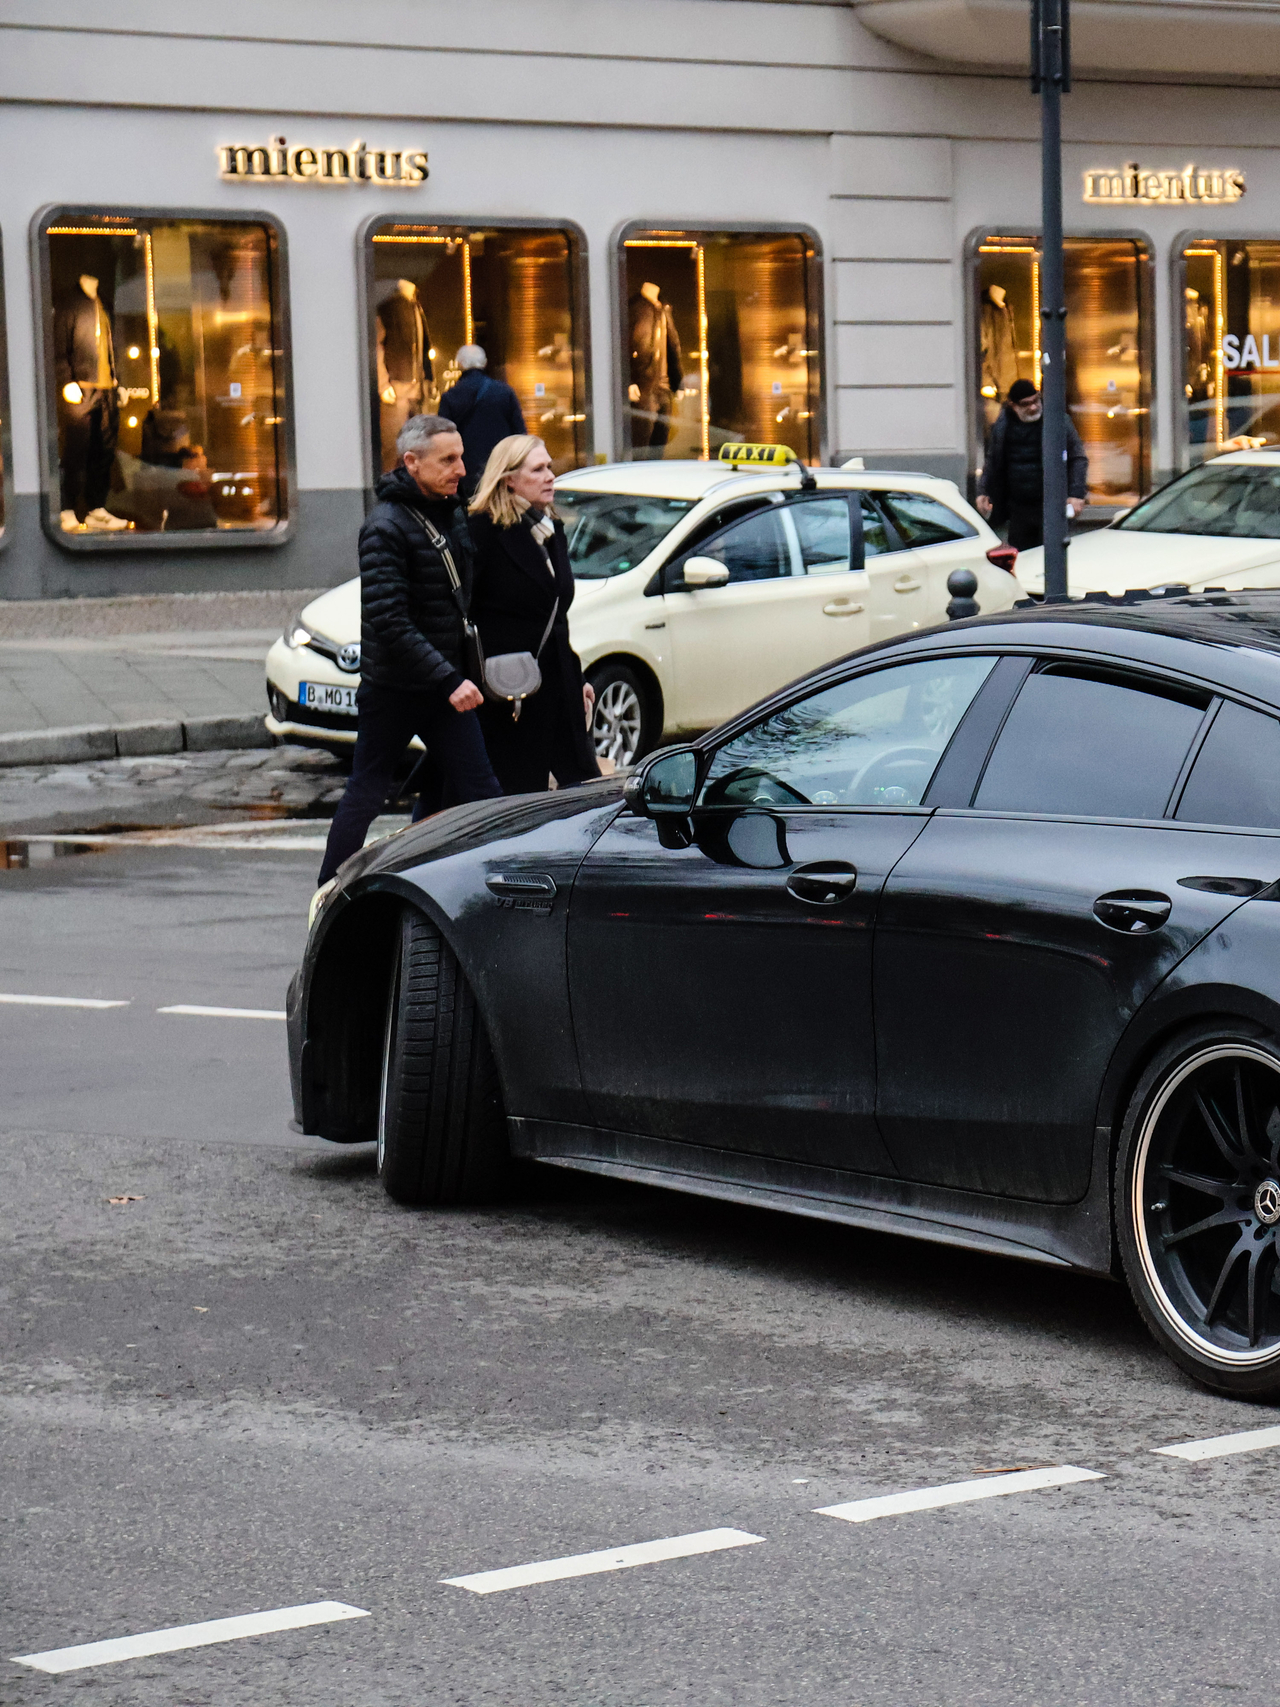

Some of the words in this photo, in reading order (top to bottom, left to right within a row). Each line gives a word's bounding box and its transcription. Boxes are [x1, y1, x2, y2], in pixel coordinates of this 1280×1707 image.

[218, 135, 429, 183] mientus
[1084, 161, 1247, 202] mientus
[728, 446, 771, 460] TAXI
[307, 685, 316, 702] B
[325, 688, 342, 705] MO
[346, 691, 358, 707] 1
